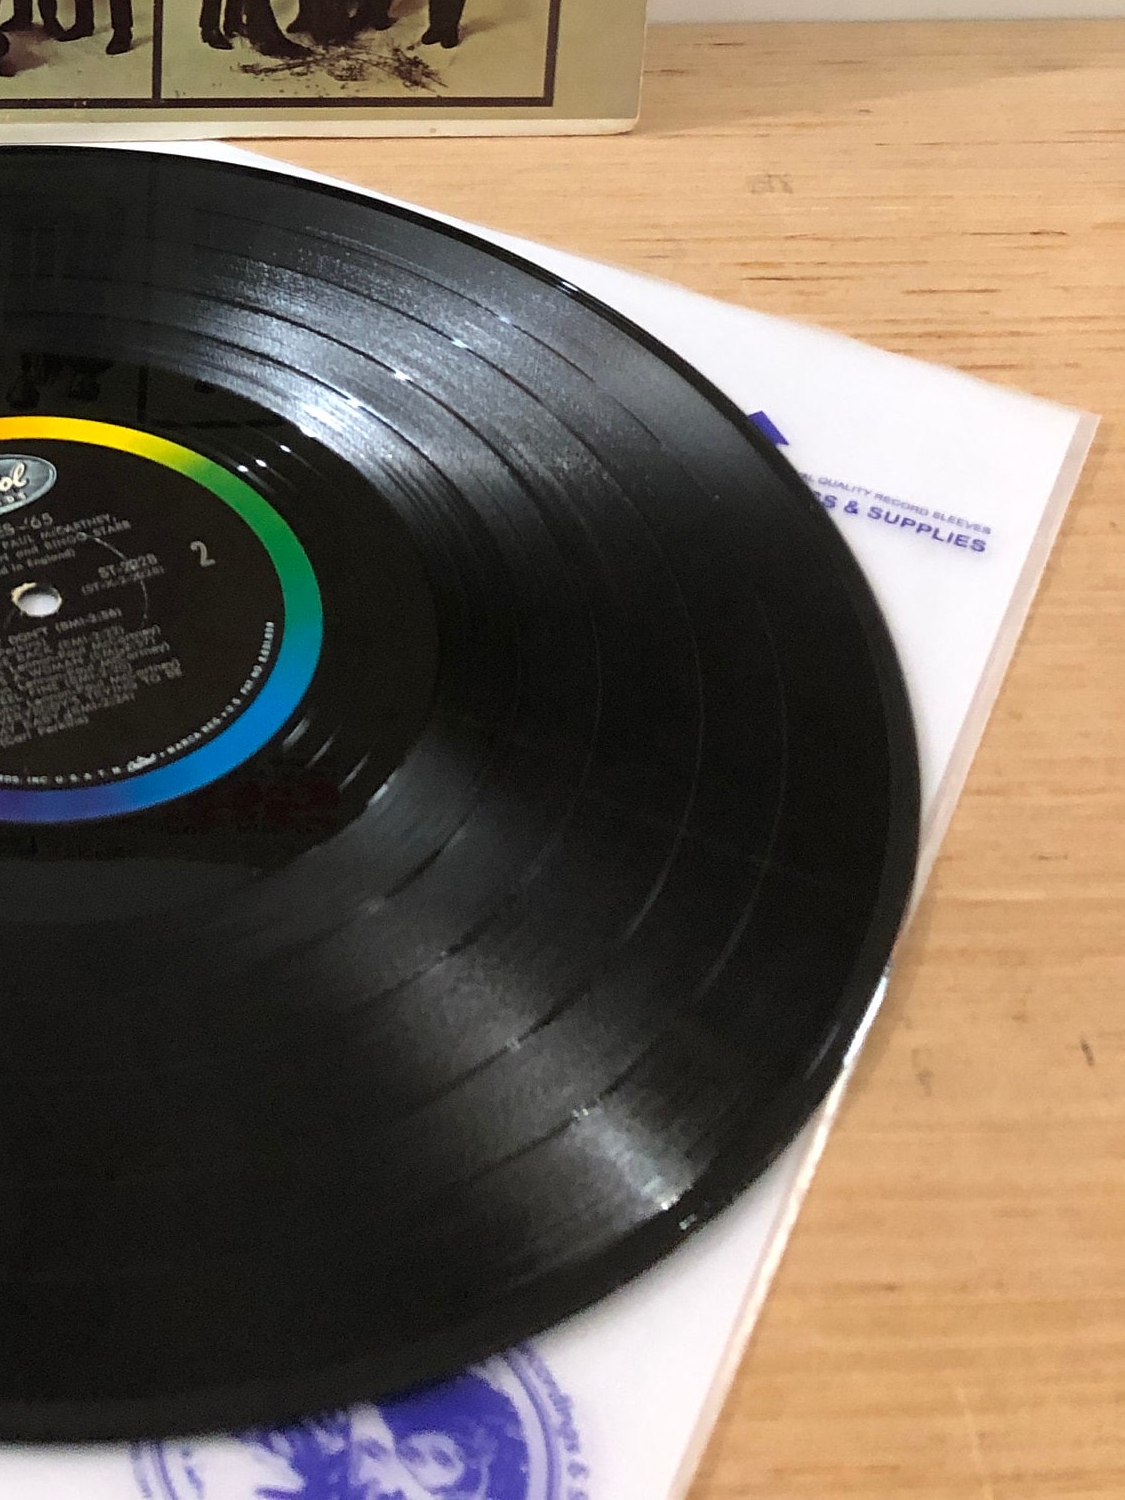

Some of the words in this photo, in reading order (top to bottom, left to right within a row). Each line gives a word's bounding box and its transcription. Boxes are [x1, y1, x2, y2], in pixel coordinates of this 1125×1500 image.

[817, 476, 871, 497] QUALITY
[873, 493, 929, 517] RECORD
[931, 510, 992, 535] SLEEVES
[92, 519, 132, 538] STARR
[843, 500, 860, 515] &
[866, 505, 987, 554] SUPPLIES
[1, 534, 35, 550] PAUL
[190, 540, 216, 568] 2
